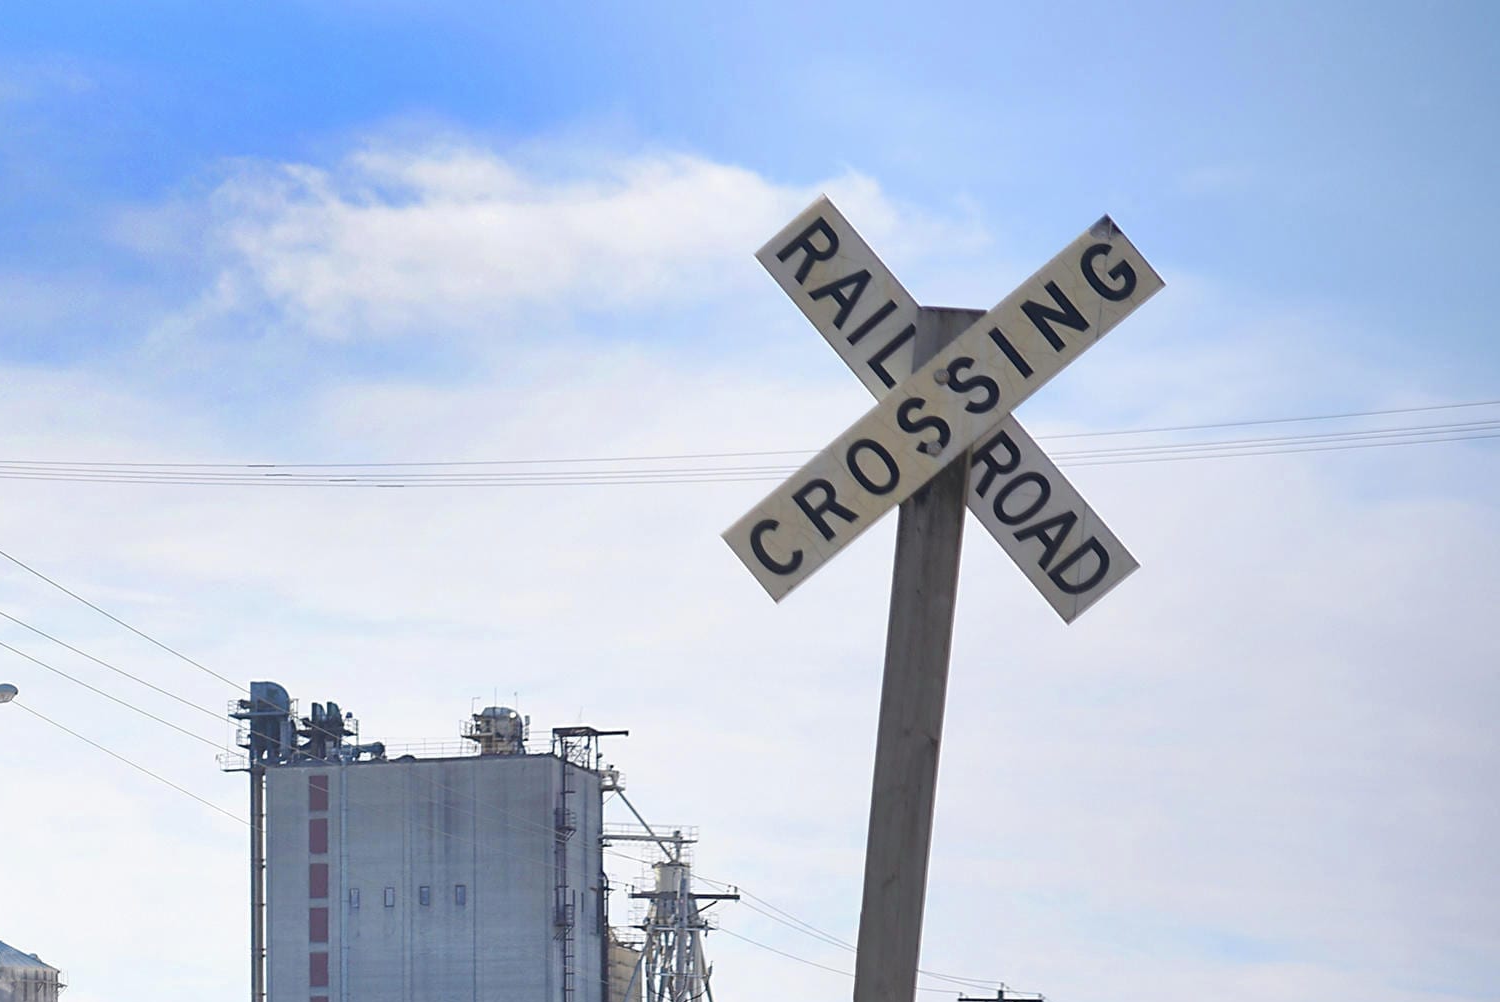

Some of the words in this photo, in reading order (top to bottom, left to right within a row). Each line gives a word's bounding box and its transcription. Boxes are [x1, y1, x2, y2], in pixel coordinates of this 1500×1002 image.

[776, 216, 916, 389] RAIL
[749, 242, 1137, 576] CROSSING
[971, 429, 1110, 595] ROAD
